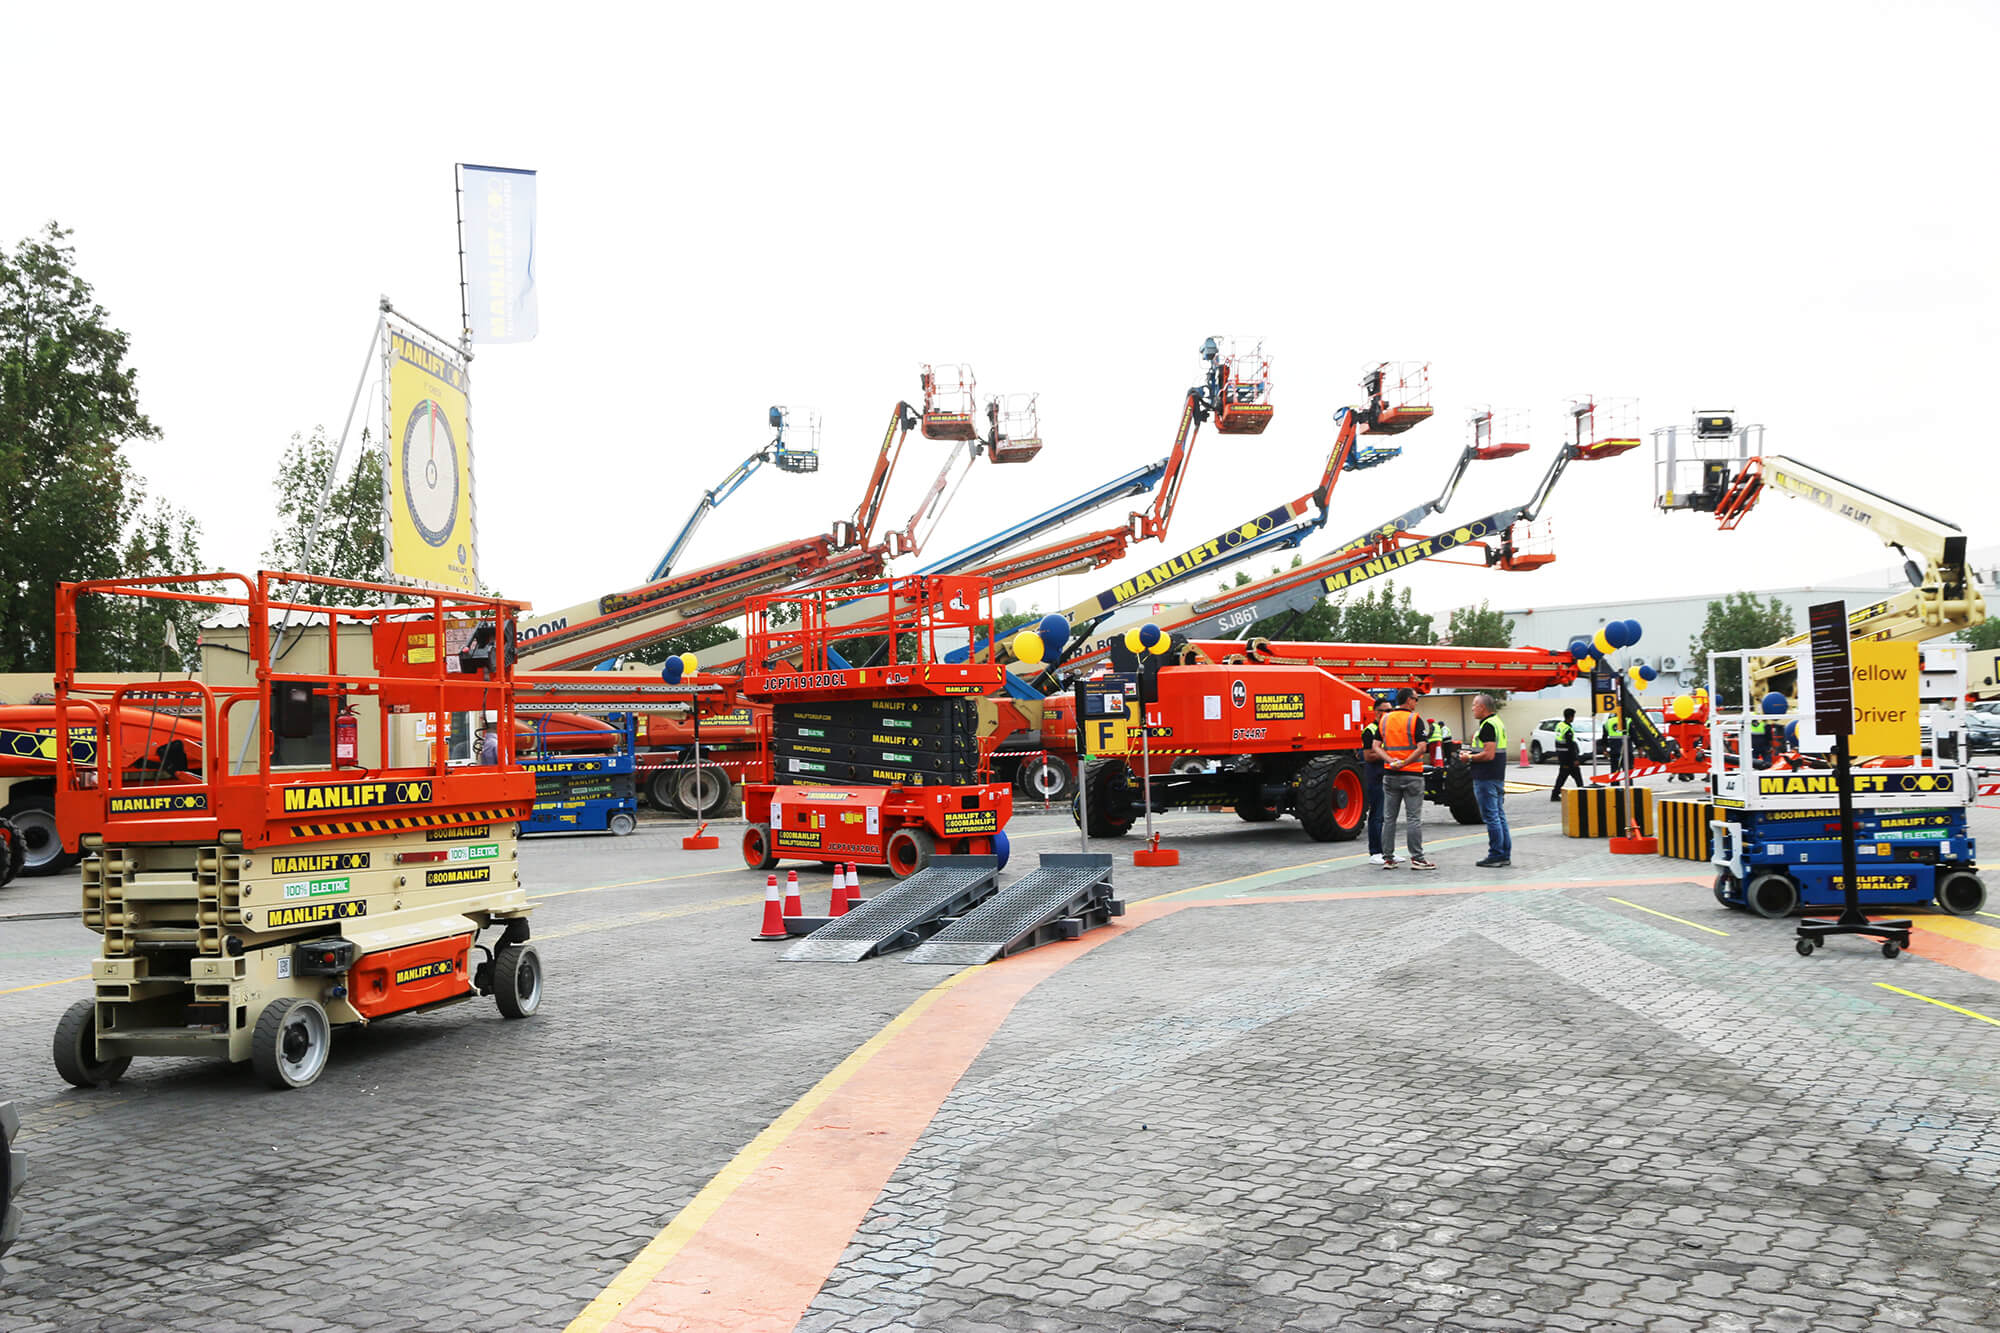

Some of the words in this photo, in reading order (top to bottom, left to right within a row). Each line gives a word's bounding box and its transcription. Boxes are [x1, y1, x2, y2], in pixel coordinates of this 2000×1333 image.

[392, 335, 446, 379] MANLIFT
[1854, 510, 1872, 525] LIFT
[1111, 538, 1220, 602] MANLIFT
[1325, 541, 1433, 592] MANLIFT
[1217, 606, 1259, 632] SJ86T
[763, 673, 848, 691] JCPT1912DCL
[872, 701, 906, 711] MANLIFT
[1256, 695, 1288, 703] MANLIFT
[1603, 695, 1615, 711] B
[872, 735, 906, 745] MANLIFT
[1098, 722, 1114, 750] F
[1232, 727, 1267, 740] BT44RT
[873, 770, 907, 781] MANLIFT
[1761, 777, 1888, 793] MANLFT
[111, 797, 171, 811] MANLIFT
[285, 784, 386, 811] MANLIFT
[945, 812, 980, 821] MANLIFT
[1881, 817, 1927, 827] MANLIFT
[469, 845, 498, 857] ELECTRIC
[273, 855, 338, 873] MANLIFT
[286, 884, 308, 897] 100%
[311, 879, 348, 894] ELECTRIC
[269, 904, 335, 926] MANLIFT
[397, 965, 432, 983] MANLIFT
